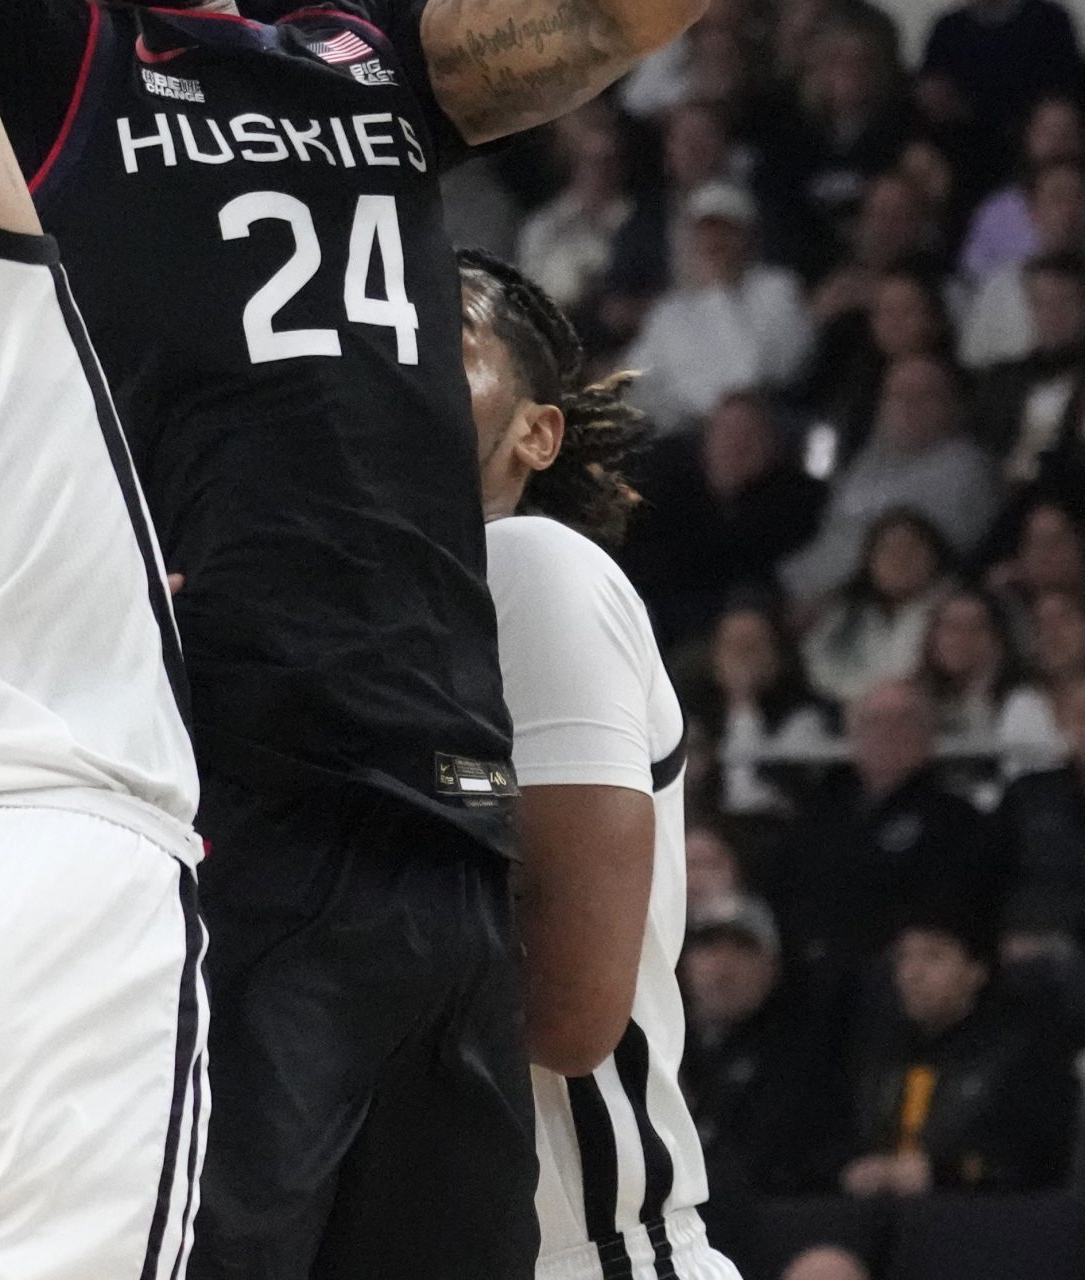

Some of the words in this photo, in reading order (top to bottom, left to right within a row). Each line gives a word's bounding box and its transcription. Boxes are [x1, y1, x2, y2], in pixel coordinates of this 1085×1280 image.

[349, 59, 381, 76] BIG
[145, 83, 205, 103] CHANGE
[117, 113, 426, 173] HUSKIES
[218, 191, 419, 365] 24
